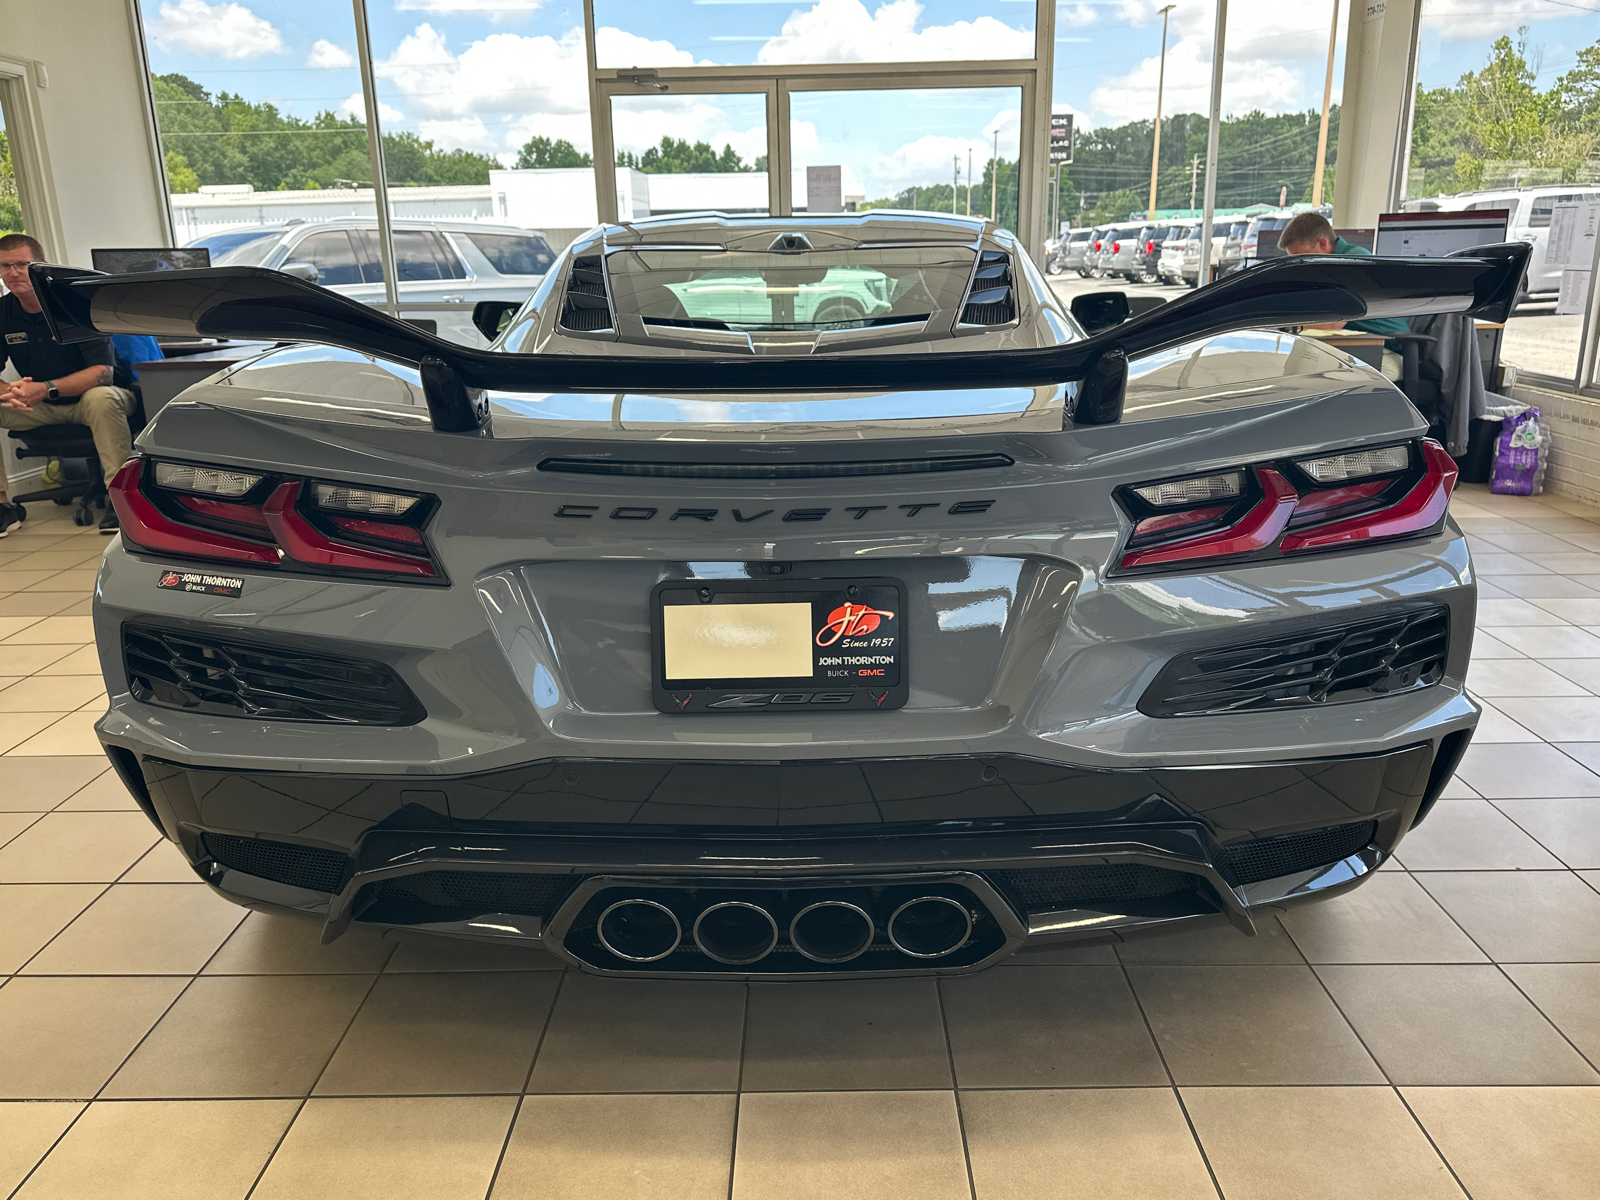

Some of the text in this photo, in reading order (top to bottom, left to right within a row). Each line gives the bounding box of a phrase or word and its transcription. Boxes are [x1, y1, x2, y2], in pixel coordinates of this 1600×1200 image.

[553, 500, 997, 522] CORVETTE
[181, 573, 242, 588] JOHN THORNTON
[841, 638, 894, 647] Since 1957
[818, 655, 894, 666] JOHN THORNTON
[827, 669, 849, 677] BUICK
